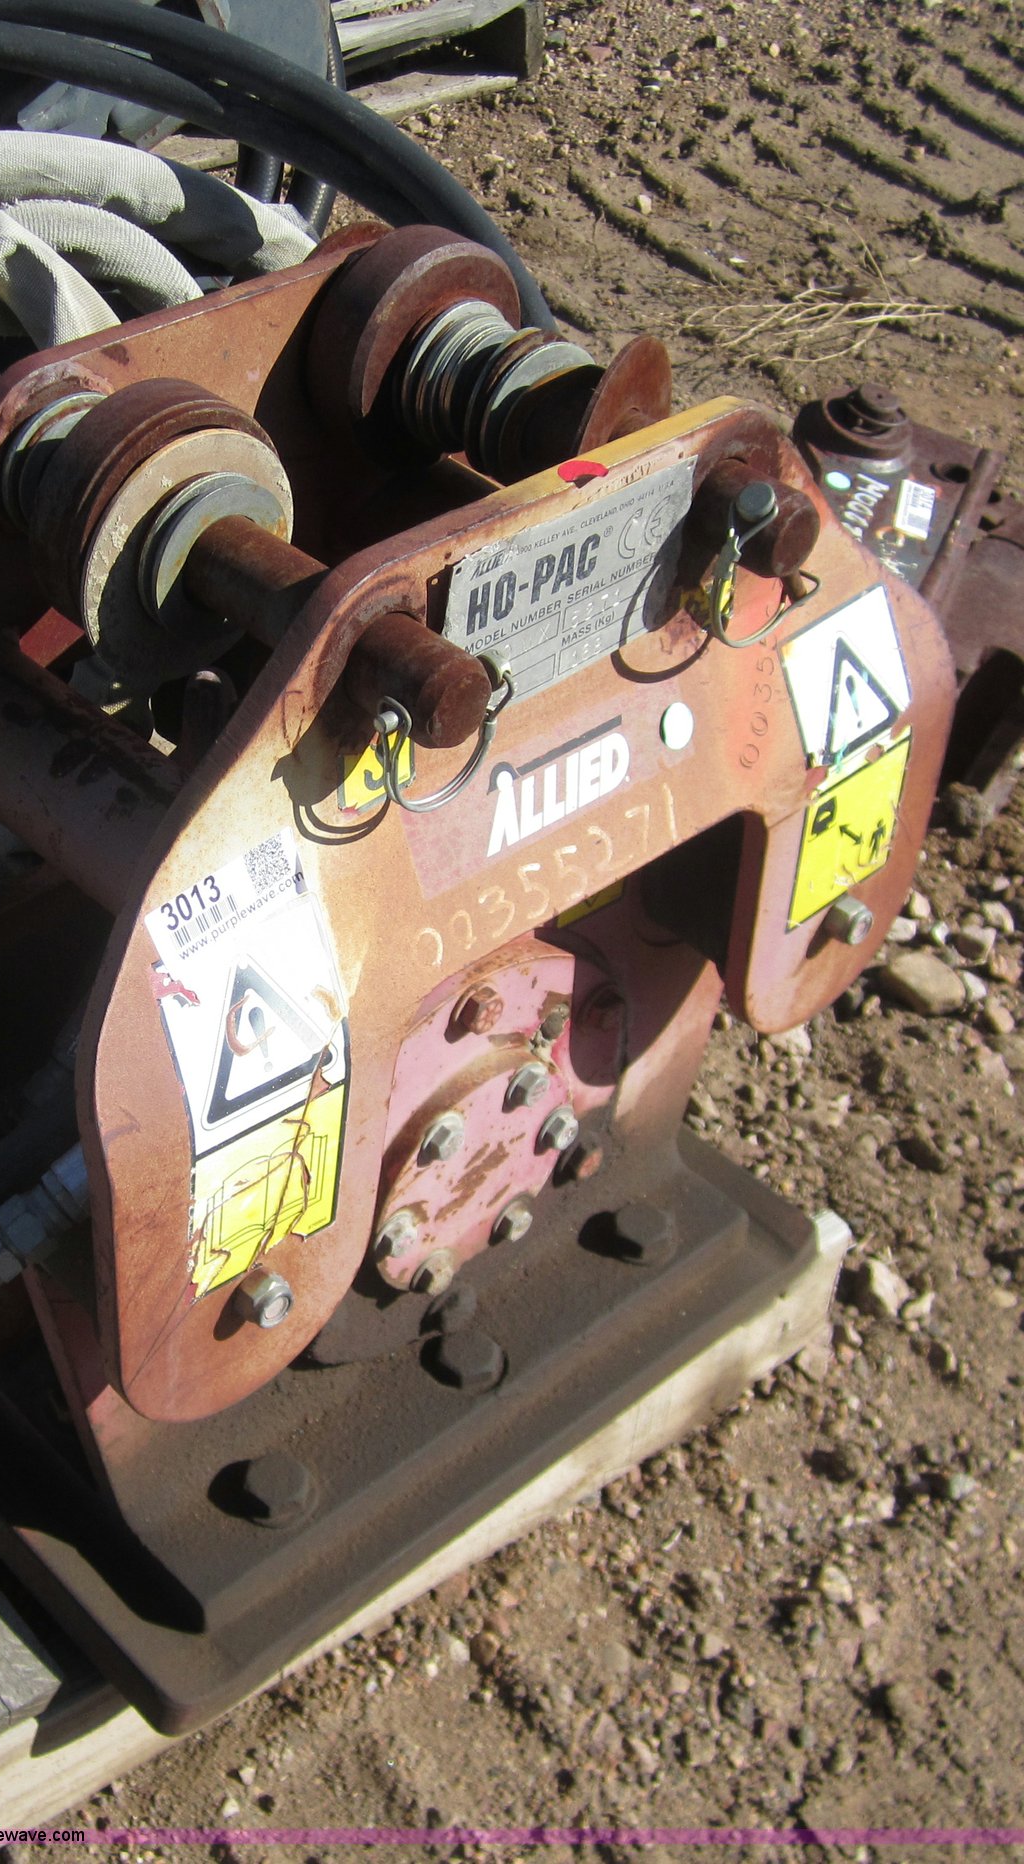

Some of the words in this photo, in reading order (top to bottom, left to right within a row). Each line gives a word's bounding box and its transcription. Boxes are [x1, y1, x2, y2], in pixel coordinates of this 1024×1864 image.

[466, 533, 601, 636] HO-PAC
[534, 533, 560, 551] KELLEY
[465, 630, 507, 654] MODEL
[511, 600, 562, 631] NUMBER
[567, 579, 606, 604] SERIAL
[610, 553, 657, 583] NUMBER
[561, 622, 592, 647] MASS
[594, 611, 616, 631] (Kg)
[487, 730, 631, 857] ALLIED
[161, 875, 221, 931] 3013
[179, 871, 305, 961] www.purplewave.com
